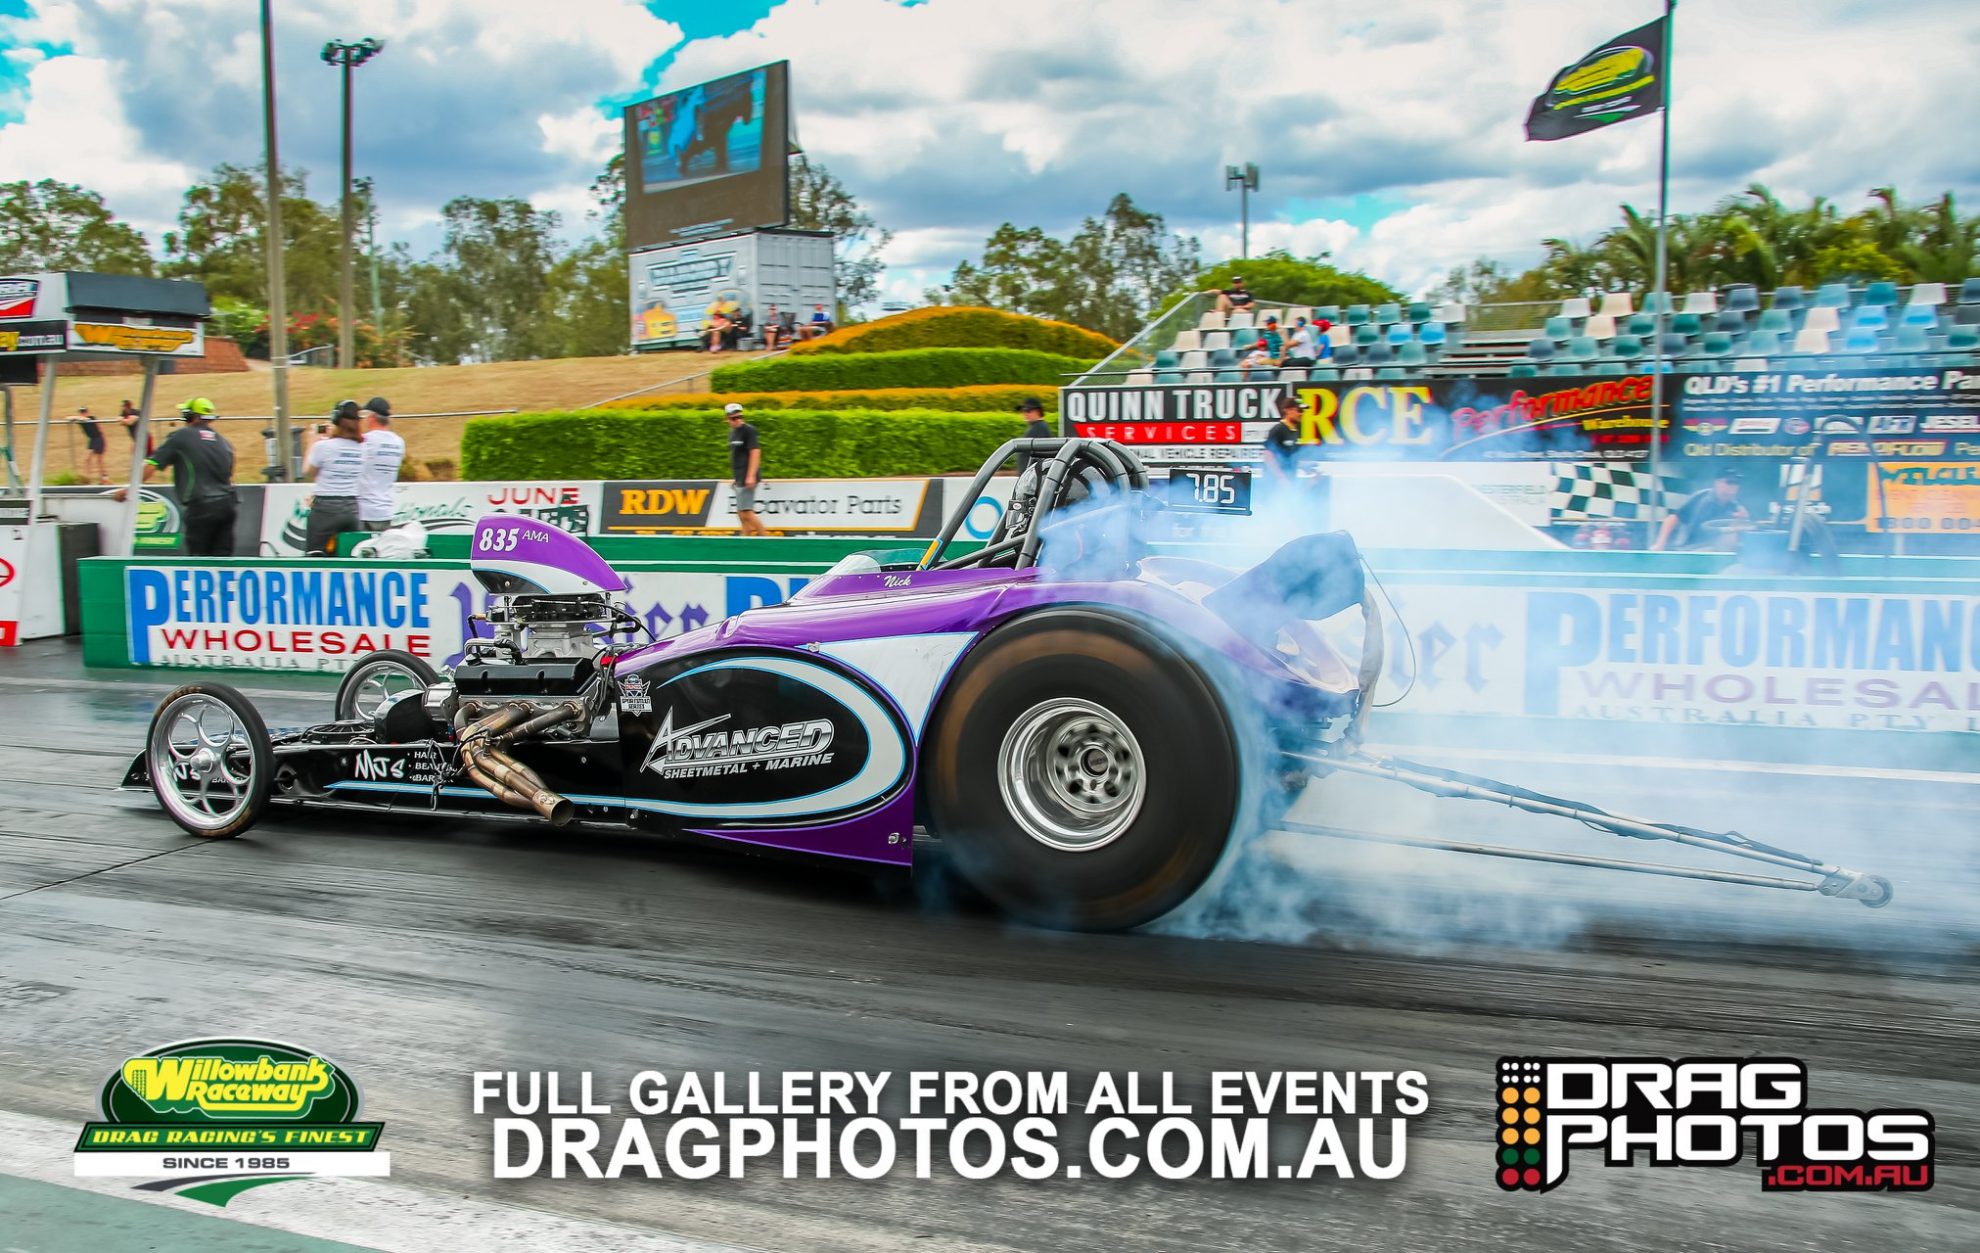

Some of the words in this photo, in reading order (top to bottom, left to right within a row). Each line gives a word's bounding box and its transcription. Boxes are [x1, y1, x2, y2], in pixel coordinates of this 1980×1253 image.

[1684, 376, 1749, 394] QLD's
[1752, 374, 1781, 393] #1
[1786, 373, 1938, 392] Performance
[1067, 390, 1164, 422] QUINN
[1173, 388, 1282, 420] TRUCK
[1297, 386, 1433, 446] RCE
[1452, 376, 1654, 440] Performance
[1086, 426, 1236, 441] SERVICES
[1714, 443, 1796, 456] Distributor
[487, 487, 579, 505] JUNE
[619, 489, 709, 514] RDW
[727, 495, 838, 514] Ecavator
[846, 495, 901, 514] Parts
[479, 528, 520, 551] 835
[522, 530, 549, 542] AMA
[884, 574, 911, 587] Nick
[129, 568, 429, 663] PERFORMANCE
[161, 629, 431, 657] WHOLESALE
[160, 654, 298, 669] AUSTRALIA
[318, 658, 358, 671] PT
[639, 704, 835, 774] ADVANCED
[663, 764, 748, 779] SHEETMETAL
[765, 753, 835, 771] MARINE
